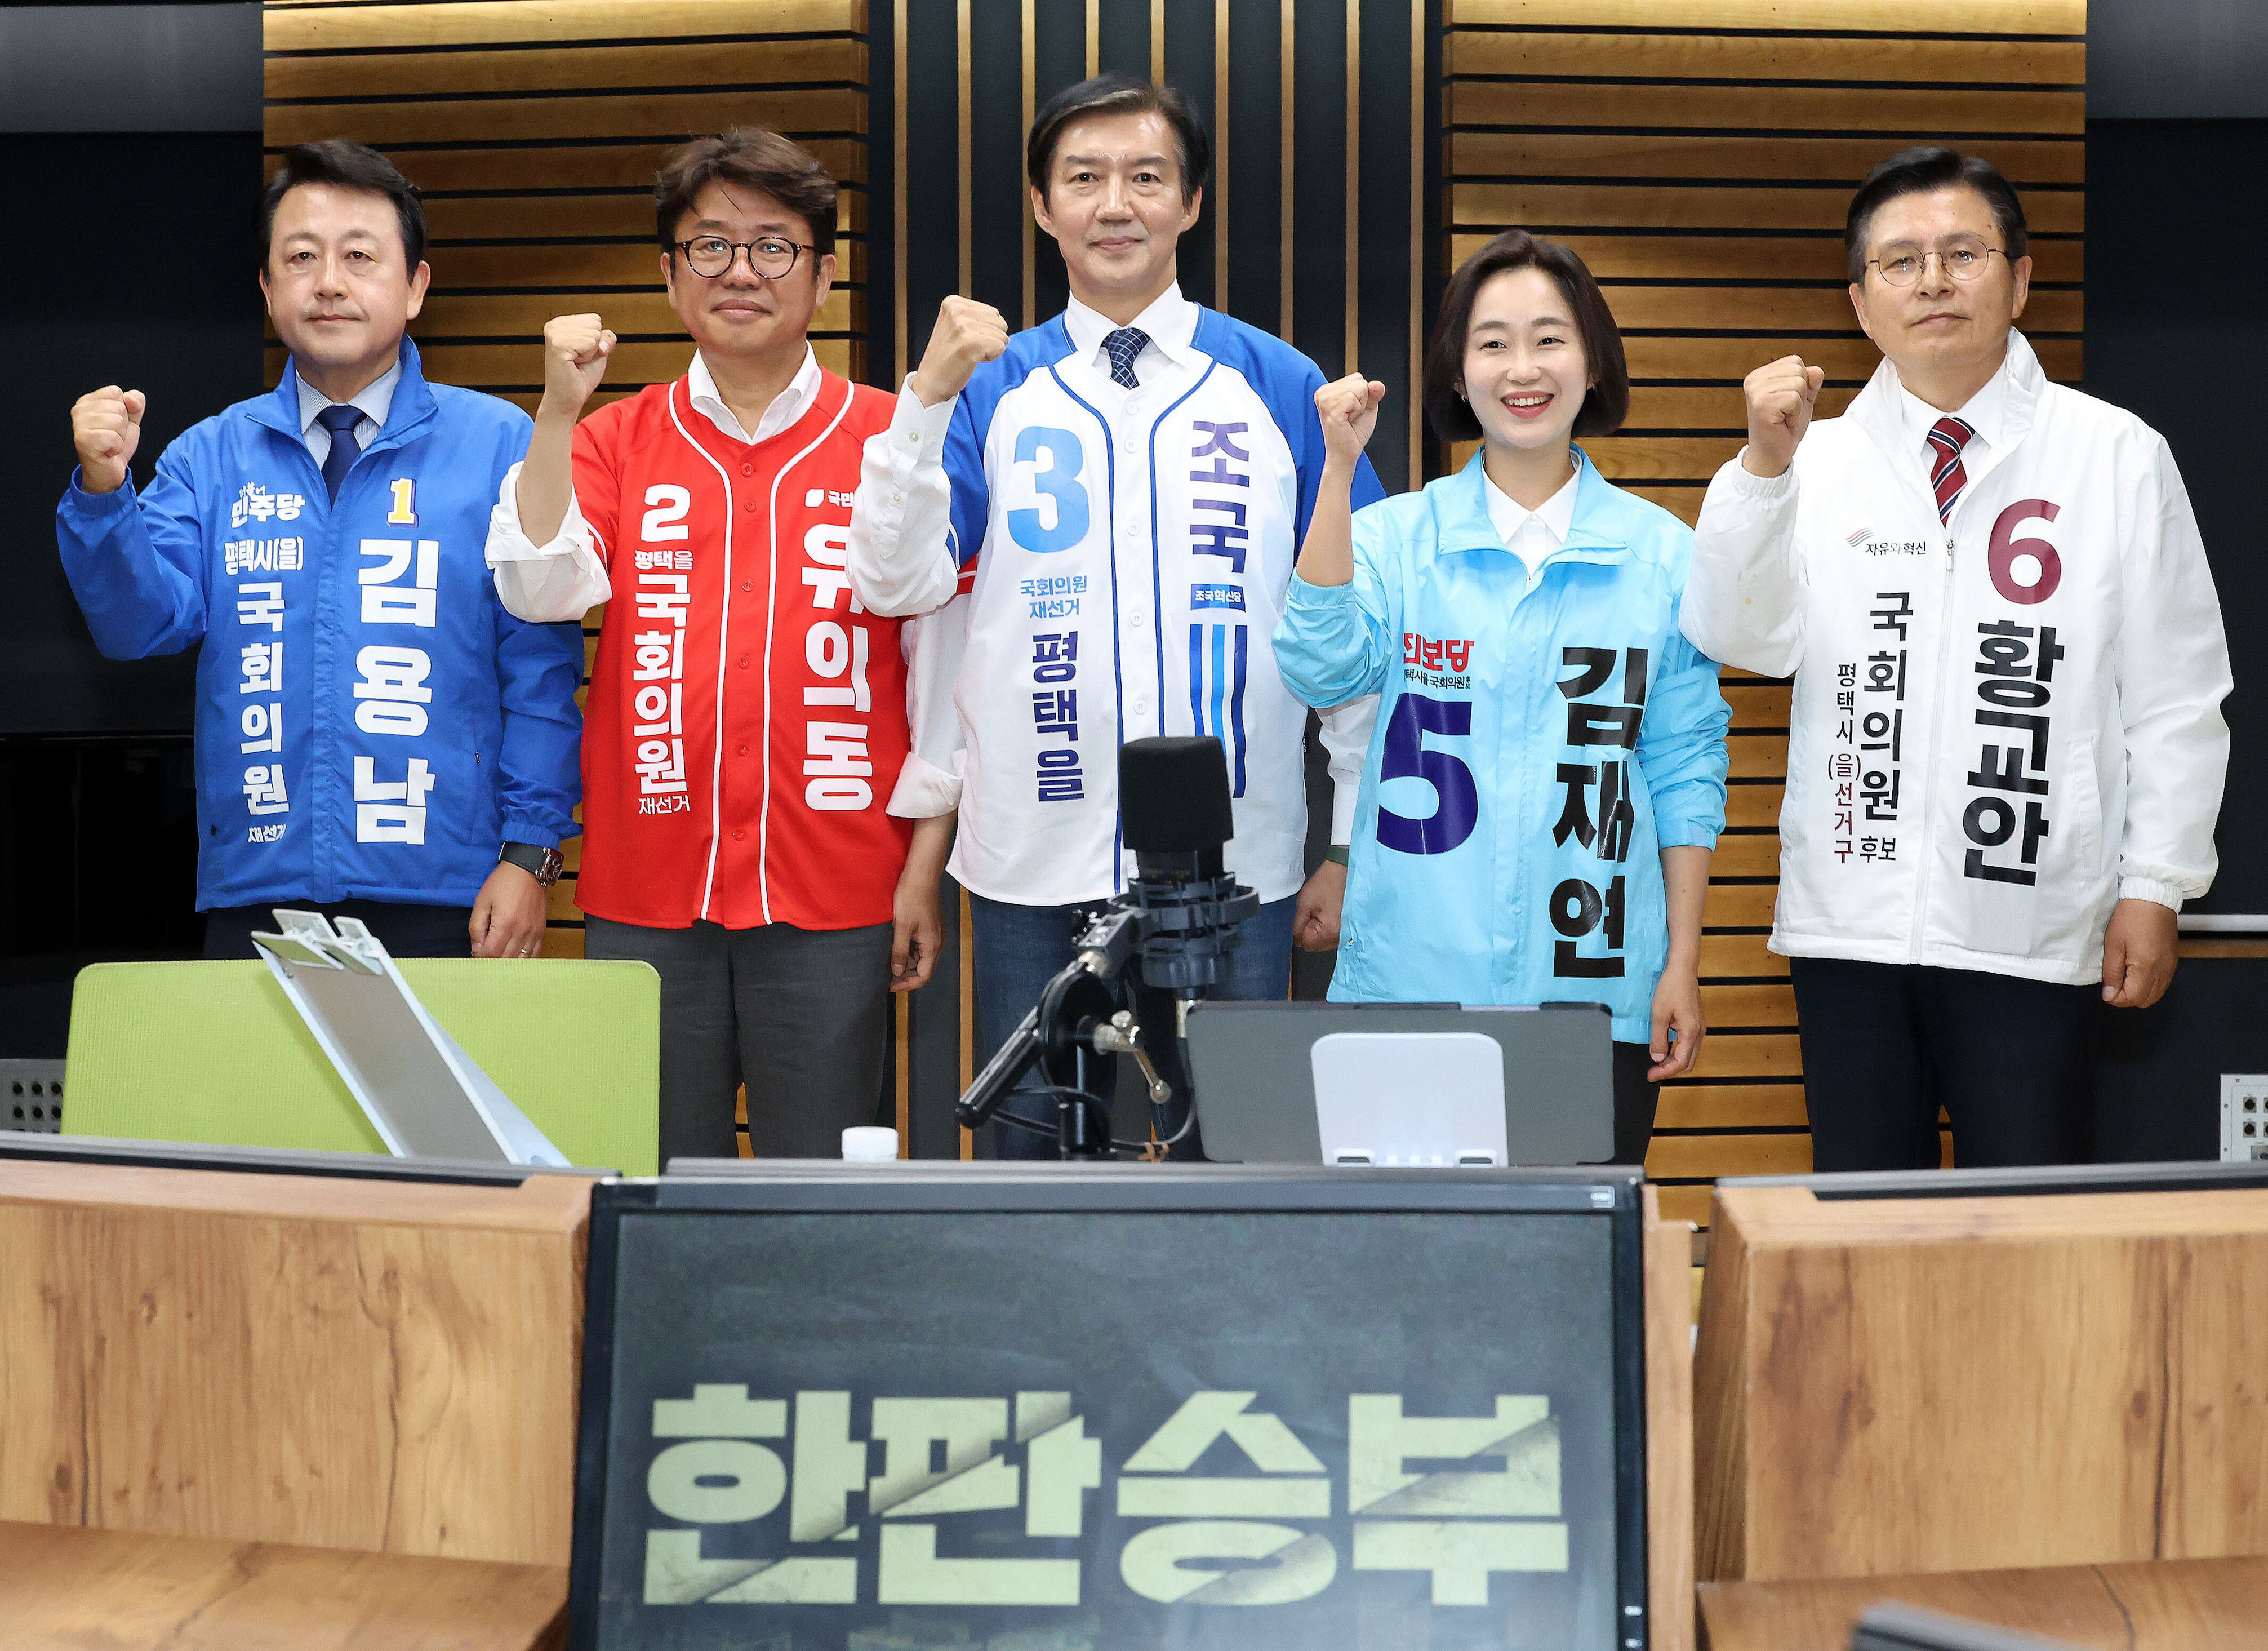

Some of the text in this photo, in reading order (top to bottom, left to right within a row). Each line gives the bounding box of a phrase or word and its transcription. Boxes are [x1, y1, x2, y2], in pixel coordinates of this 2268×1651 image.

[231, 494, 306, 528] 민주당
[386, 478, 419, 527] 1
[640, 483, 691, 542] 2
[1007, 426, 1090, 553] 3
[1190, 420, 1250, 573] 조국
[224, 536, 304, 576] 평택시(을)
[634, 549, 694, 571] 평택을
[1865, 541, 1925, 556] 자유와혁신
[1987, 499, 2062, 605] 6
[1020, 575, 1087, 597] 국회의원
[1029, 598, 1079, 619] 재선거
[1194, 589, 1242, 603] 조국혁신당
[1403, 633, 1475, 673] 진보당
[237, 582, 290, 816] 국회의원
[353, 539, 441, 845] 김용남
[633, 574, 691, 796] 국회의원
[1430, 676, 1465, 689] 국회의원
[1032, 631, 1085, 802] 평택을
[1860, 592, 1914, 864] 국회의원 후보
[1376, 693, 1478, 855] 5
[1963, 620, 2065, 886] 황교안
[638, 795, 691, 815] 재선거
[1549, 647, 1648, 977] 김재연
[248, 823, 287, 843] 재선거
